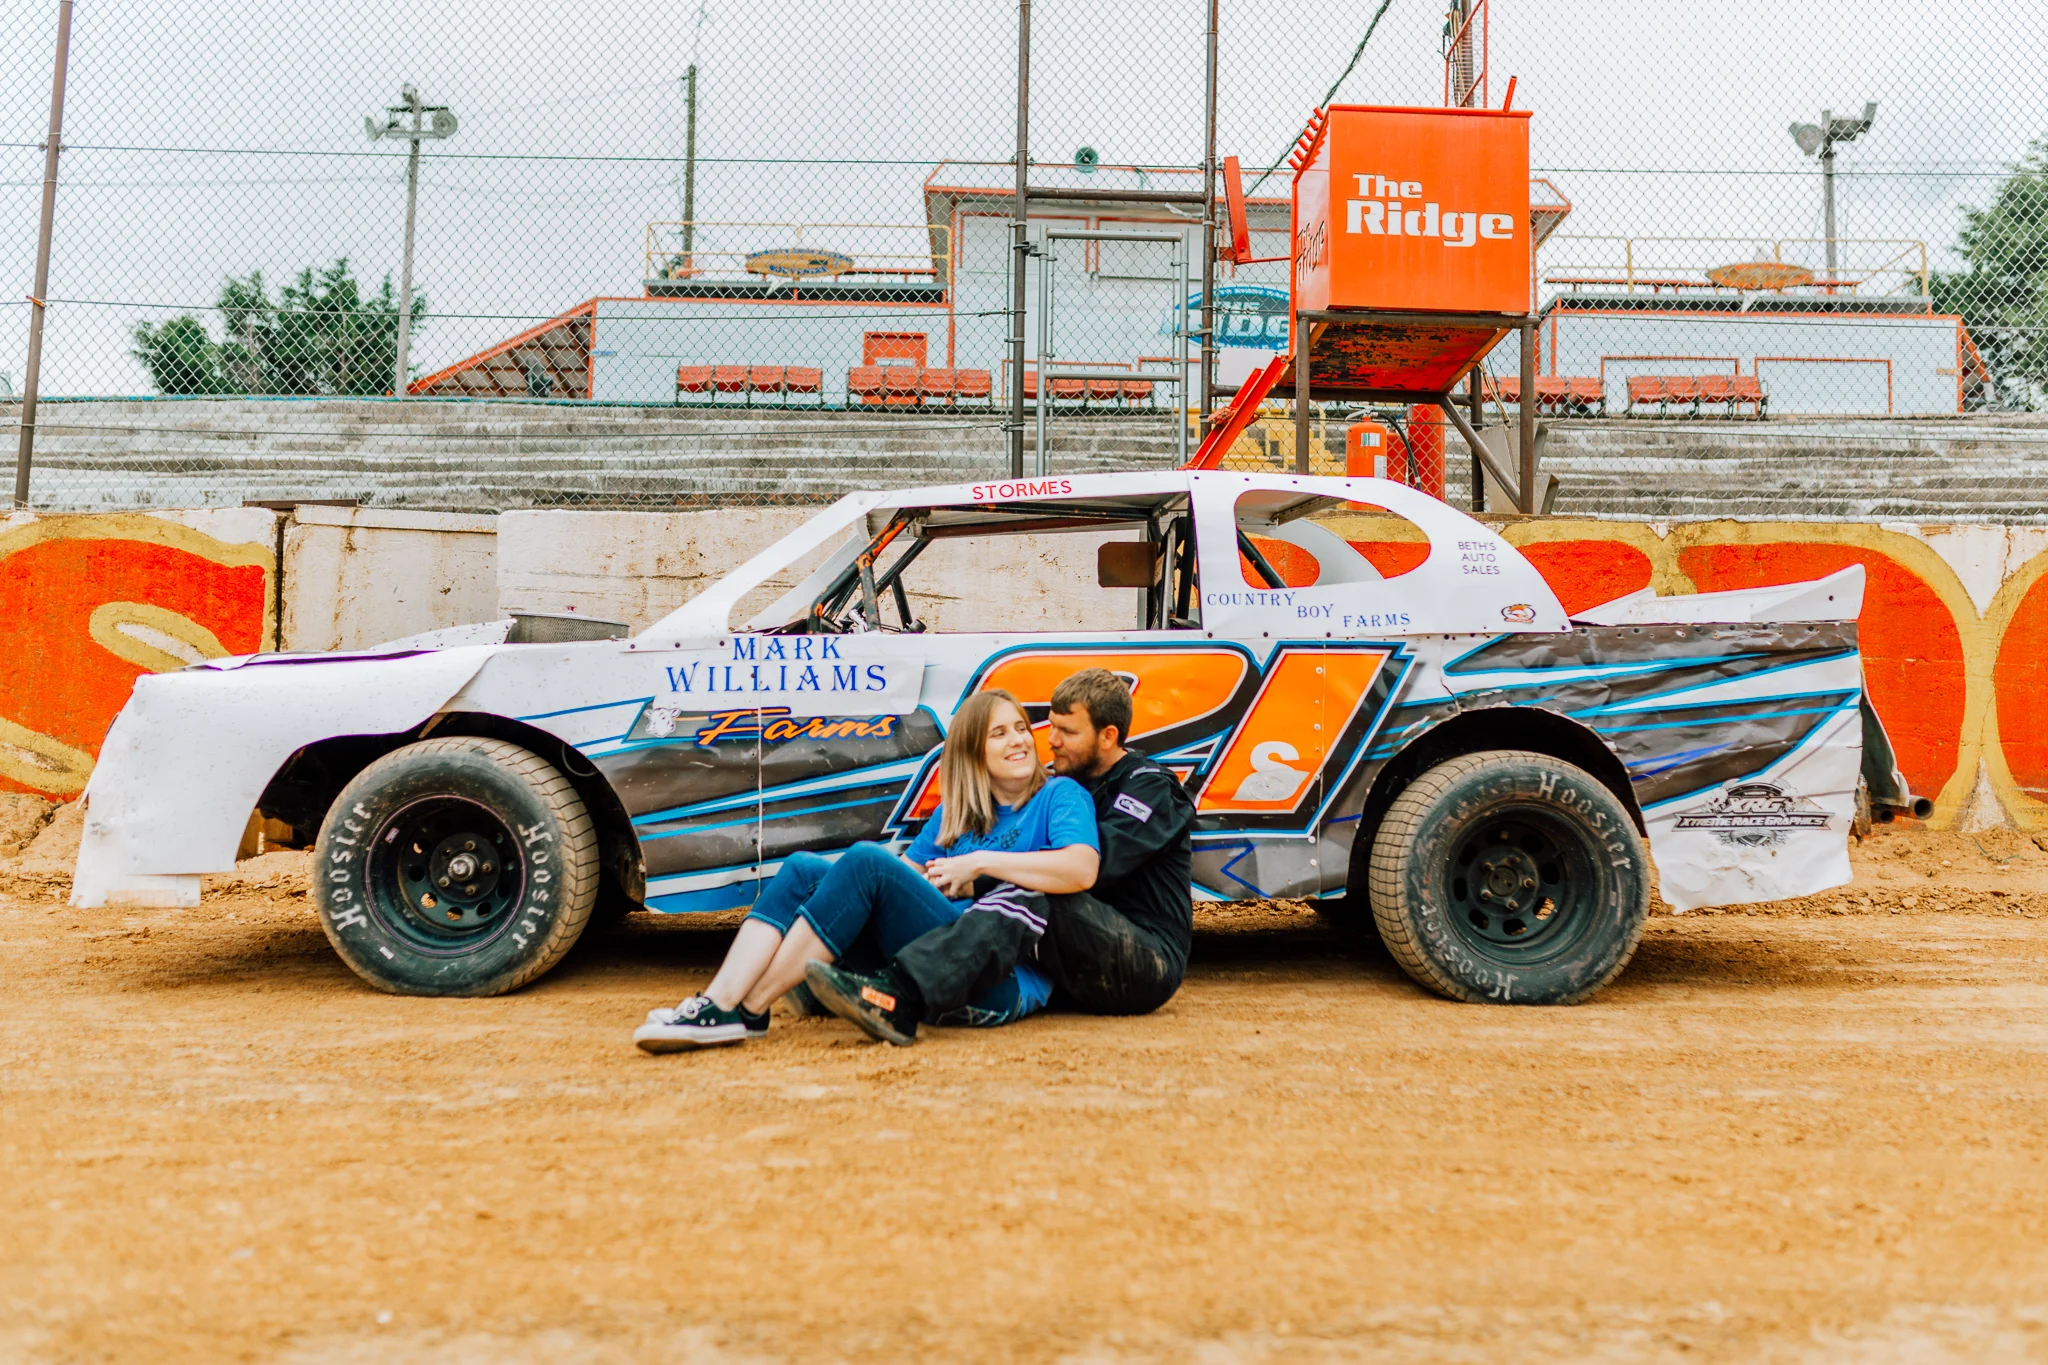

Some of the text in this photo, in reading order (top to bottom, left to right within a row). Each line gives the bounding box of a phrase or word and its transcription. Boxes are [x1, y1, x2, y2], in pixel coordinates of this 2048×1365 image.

[1352, 173, 1423, 199] The
[1346, 200, 1515, 248] Ridge
[972, 480, 1073, 500] STORMES
[1458, 541, 1497, 551] BETH'S
[1462, 553, 1496, 563] AUTO
[1463, 565, 1500, 575] SALES
[1206, 591, 1412, 629] COUNTRY BOY FARMS
[732, 636, 842, 661] MARK
[666, 661, 887, 692] WILLIAMS
[696, 706, 899, 747] Farms
[1722, 797, 1783, 814] XRG
[1532, 771, 1632, 870] Hoosier
[1681, 816, 1825, 828] XTREME RACE GRAPHICS
[329, 802, 372, 932] Hoosier
[512, 821, 554, 949] Hoosier
